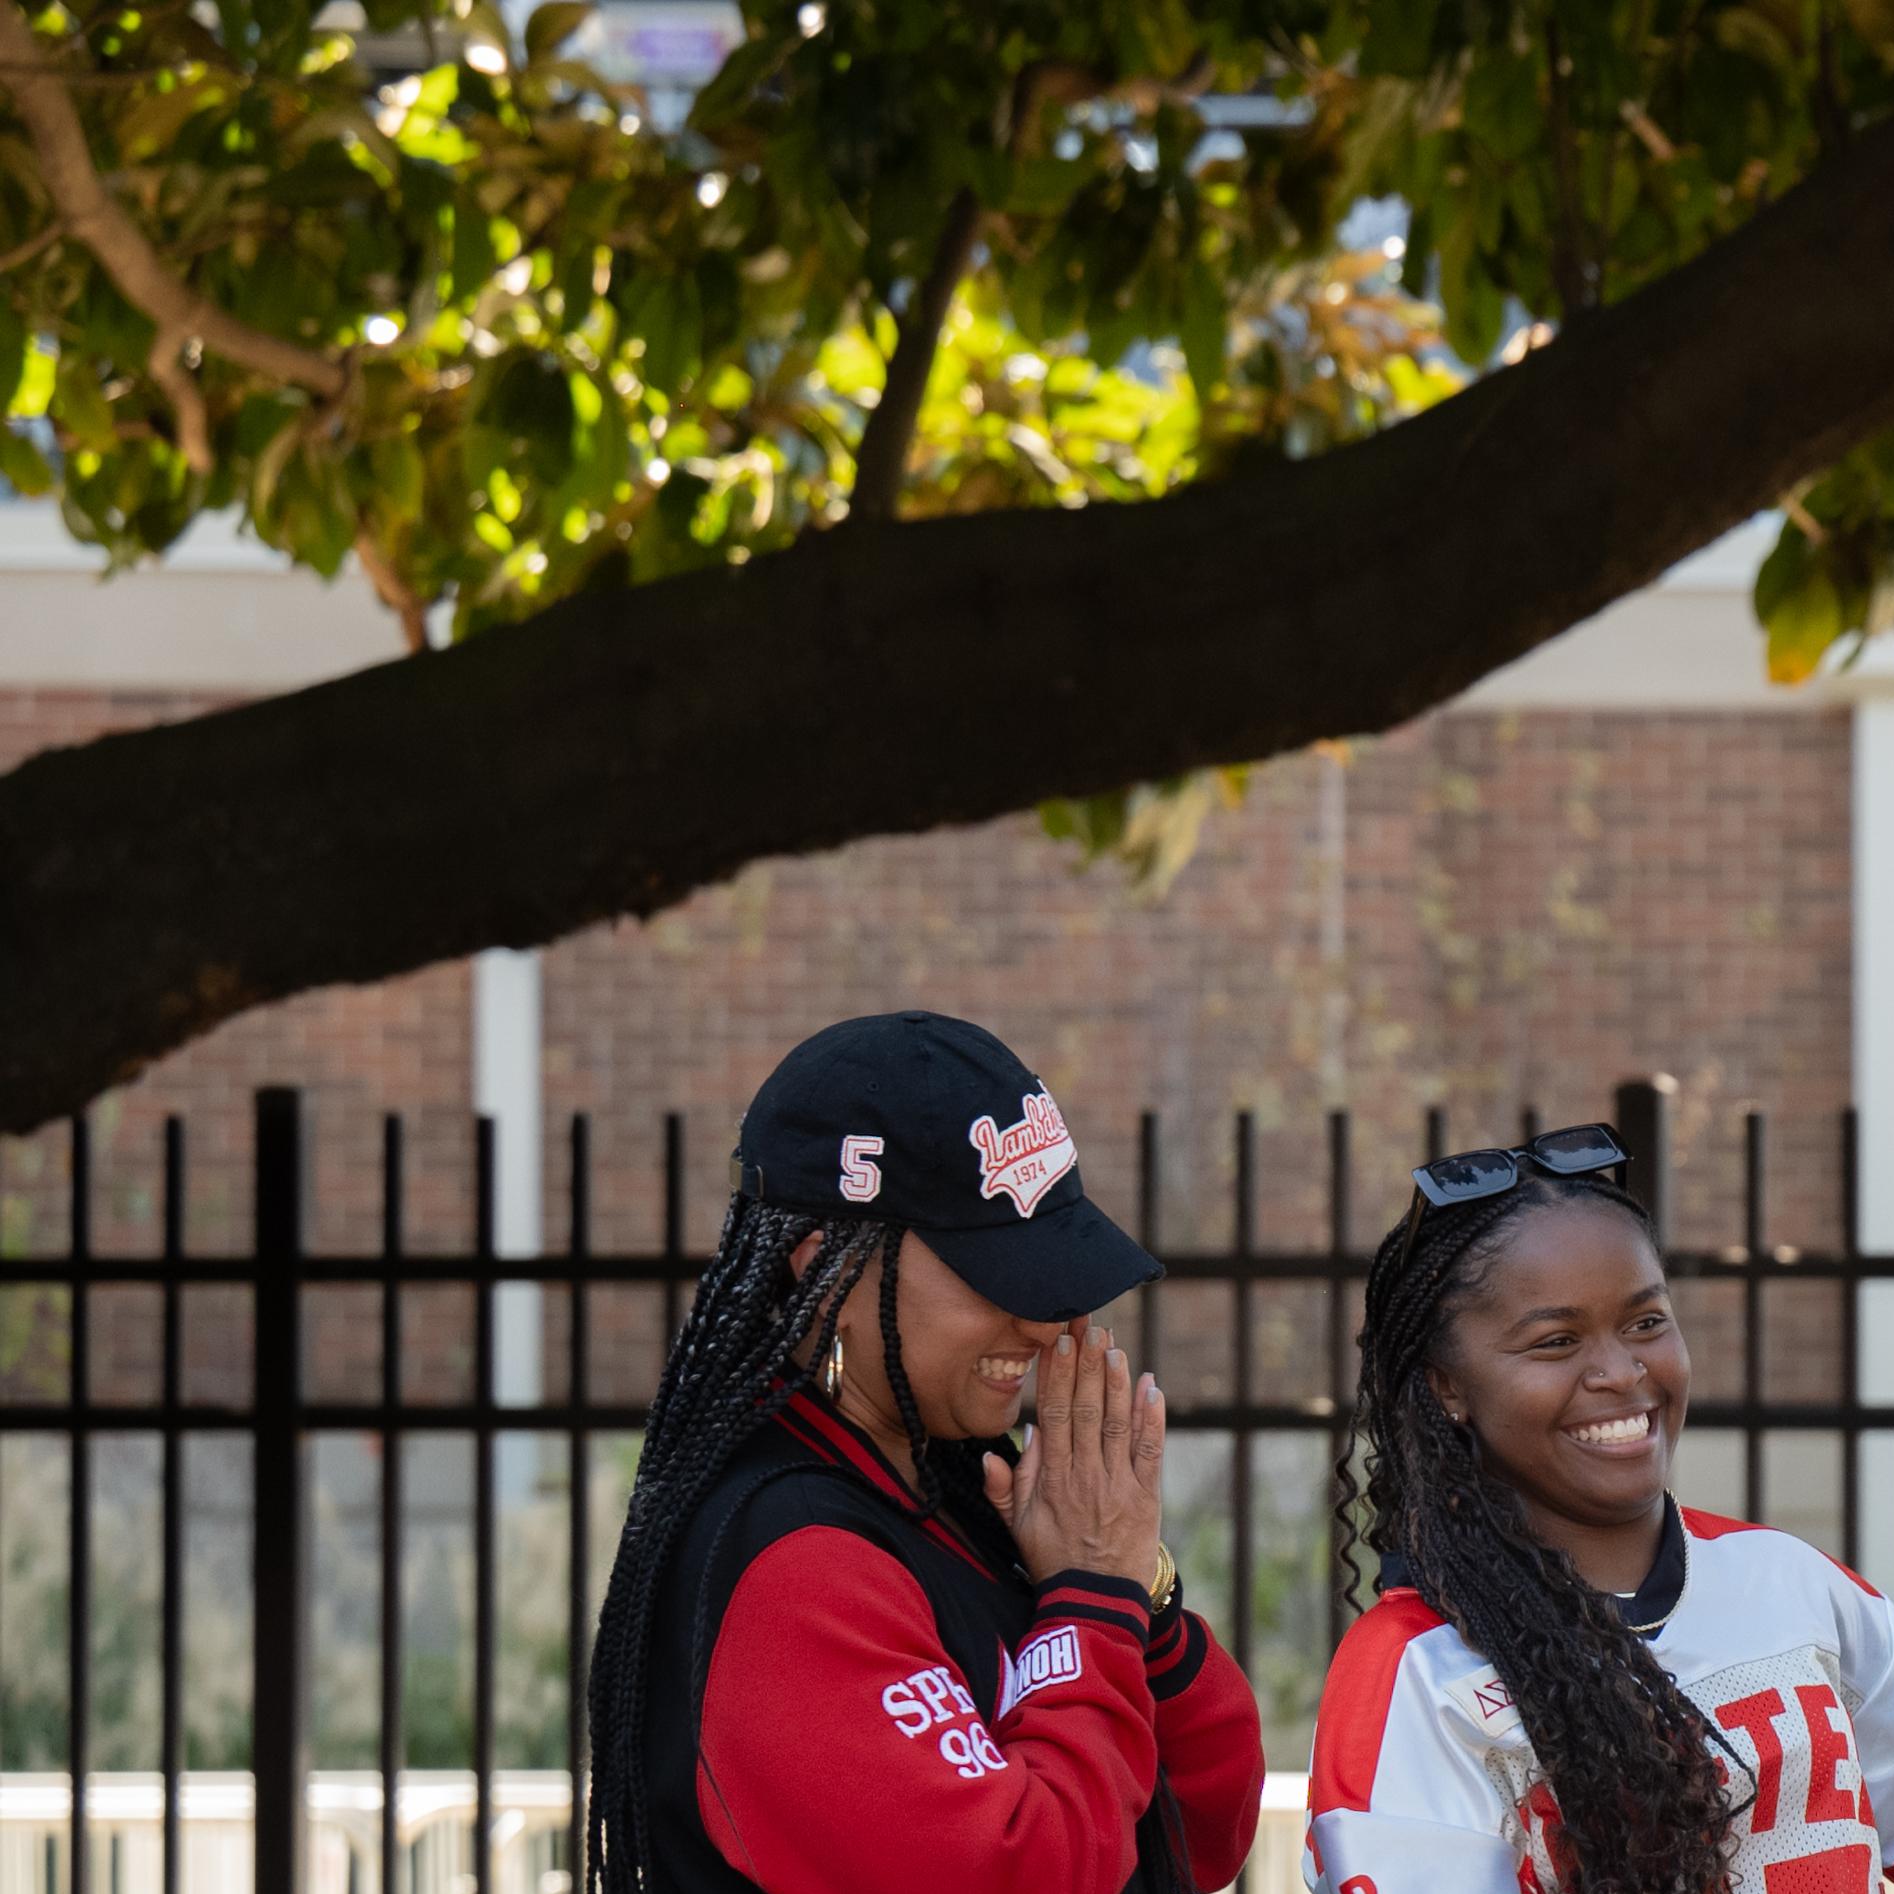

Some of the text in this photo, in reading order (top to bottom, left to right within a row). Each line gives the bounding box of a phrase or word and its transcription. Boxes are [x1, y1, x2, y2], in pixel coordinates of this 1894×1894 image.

[839, 1134, 885, 1203] 5
[1013, 1159, 1047, 1186] 1974
[939, 1721, 1008, 1778] 96
